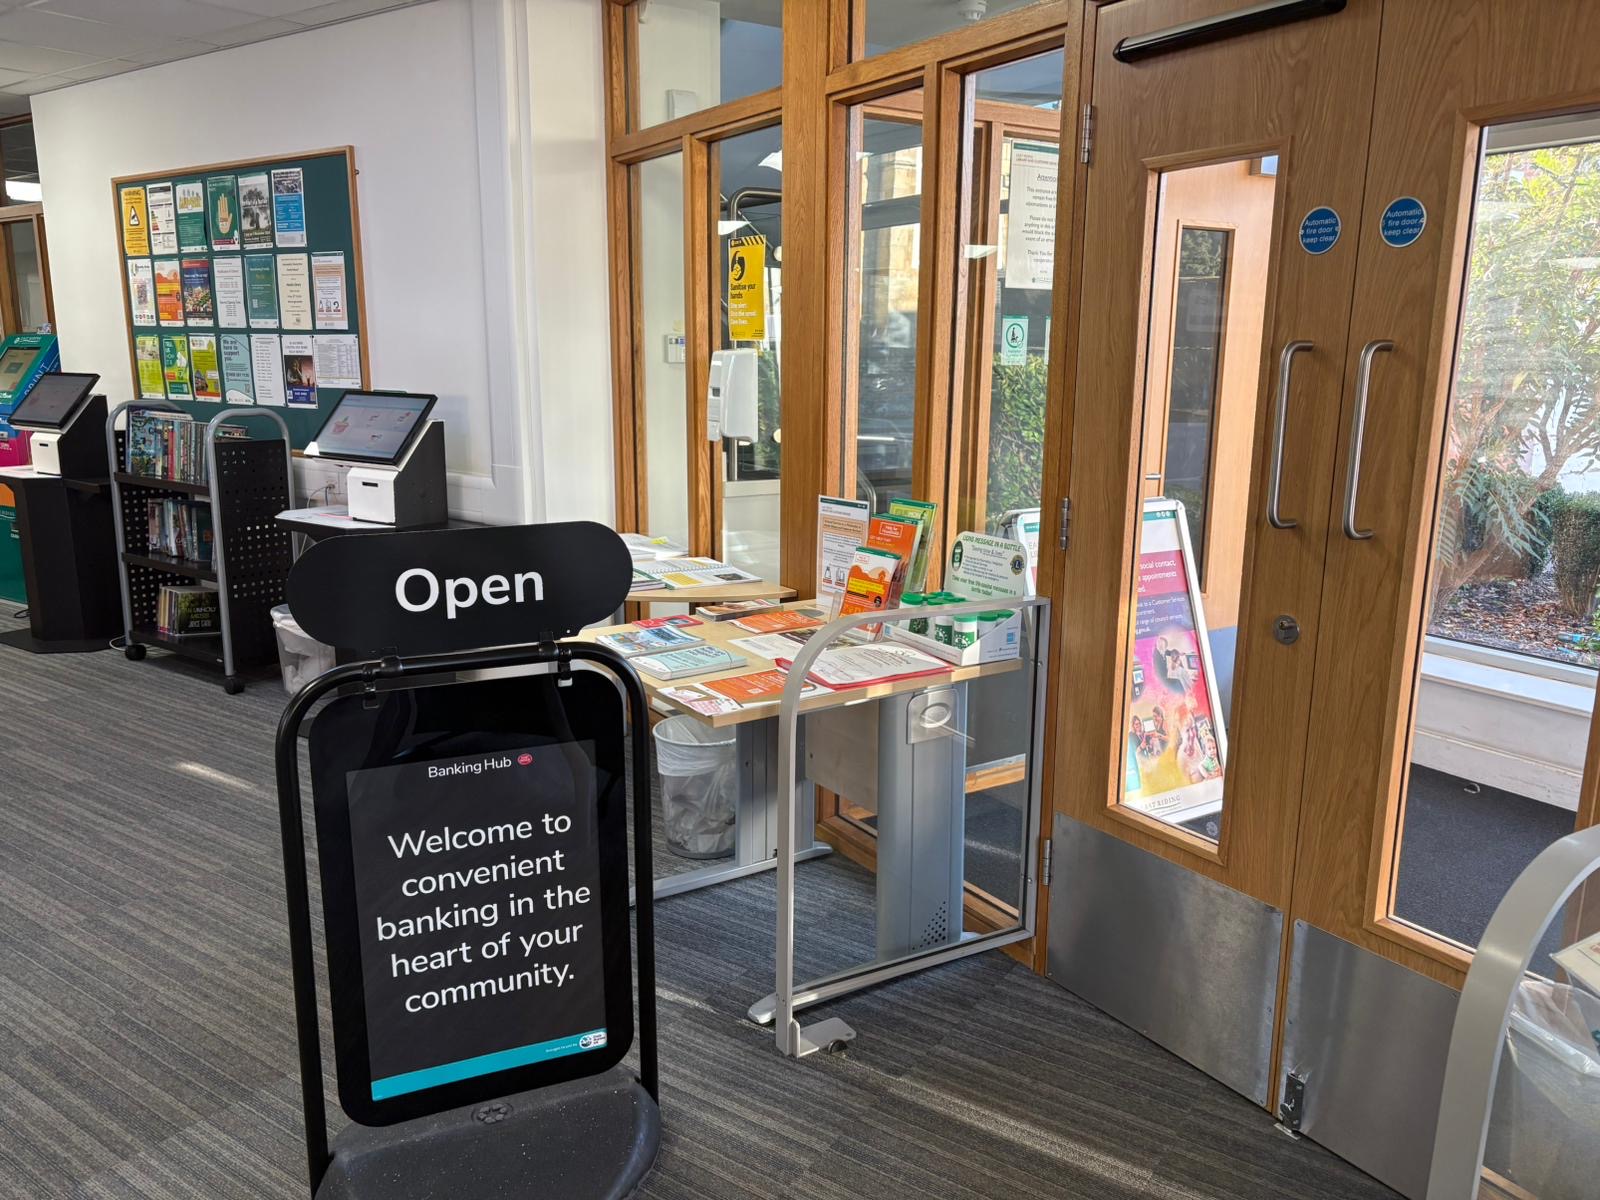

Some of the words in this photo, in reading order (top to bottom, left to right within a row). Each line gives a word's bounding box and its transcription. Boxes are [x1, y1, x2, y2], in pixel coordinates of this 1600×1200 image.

[1386, 208, 1422, 218] Automatic
[1304, 217, 1337, 227] Automatic
[1387, 218, 1400, 226] fire
[1401, 217, 1418, 226] door
[1306, 226, 1317, 235] fire
[1318, 226, 1333, 234] door
[1384, 228, 1401, 237] keep
[1402, 226, 1420, 235] clear
[1303, 236, 1318, 244] keep
[1319, 234, 1336, 242] clear
[975, 536, 994, 547] MESSAGE
[1003, 542, 1022, 552] BOTTLE
[1139, 560, 1154, 569] social
[395, 567, 544, 619] Open
[428, 761, 482, 779] Banking
[484, 756, 512, 771] Hub
[1156, 795, 1181, 806] RIDING
[388, 821, 533, 859] Welcome
[541, 813, 572, 835] to
[401, 850, 565, 897] convenient
[376, 902, 499, 941] banking
[509, 893, 535, 917] in
[543, 884, 592, 911] the
[391, 941, 473, 978] heart
[481, 932, 511, 959] of
[519, 923, 584, 957] your
[404, 962, 575, 1013] community.
